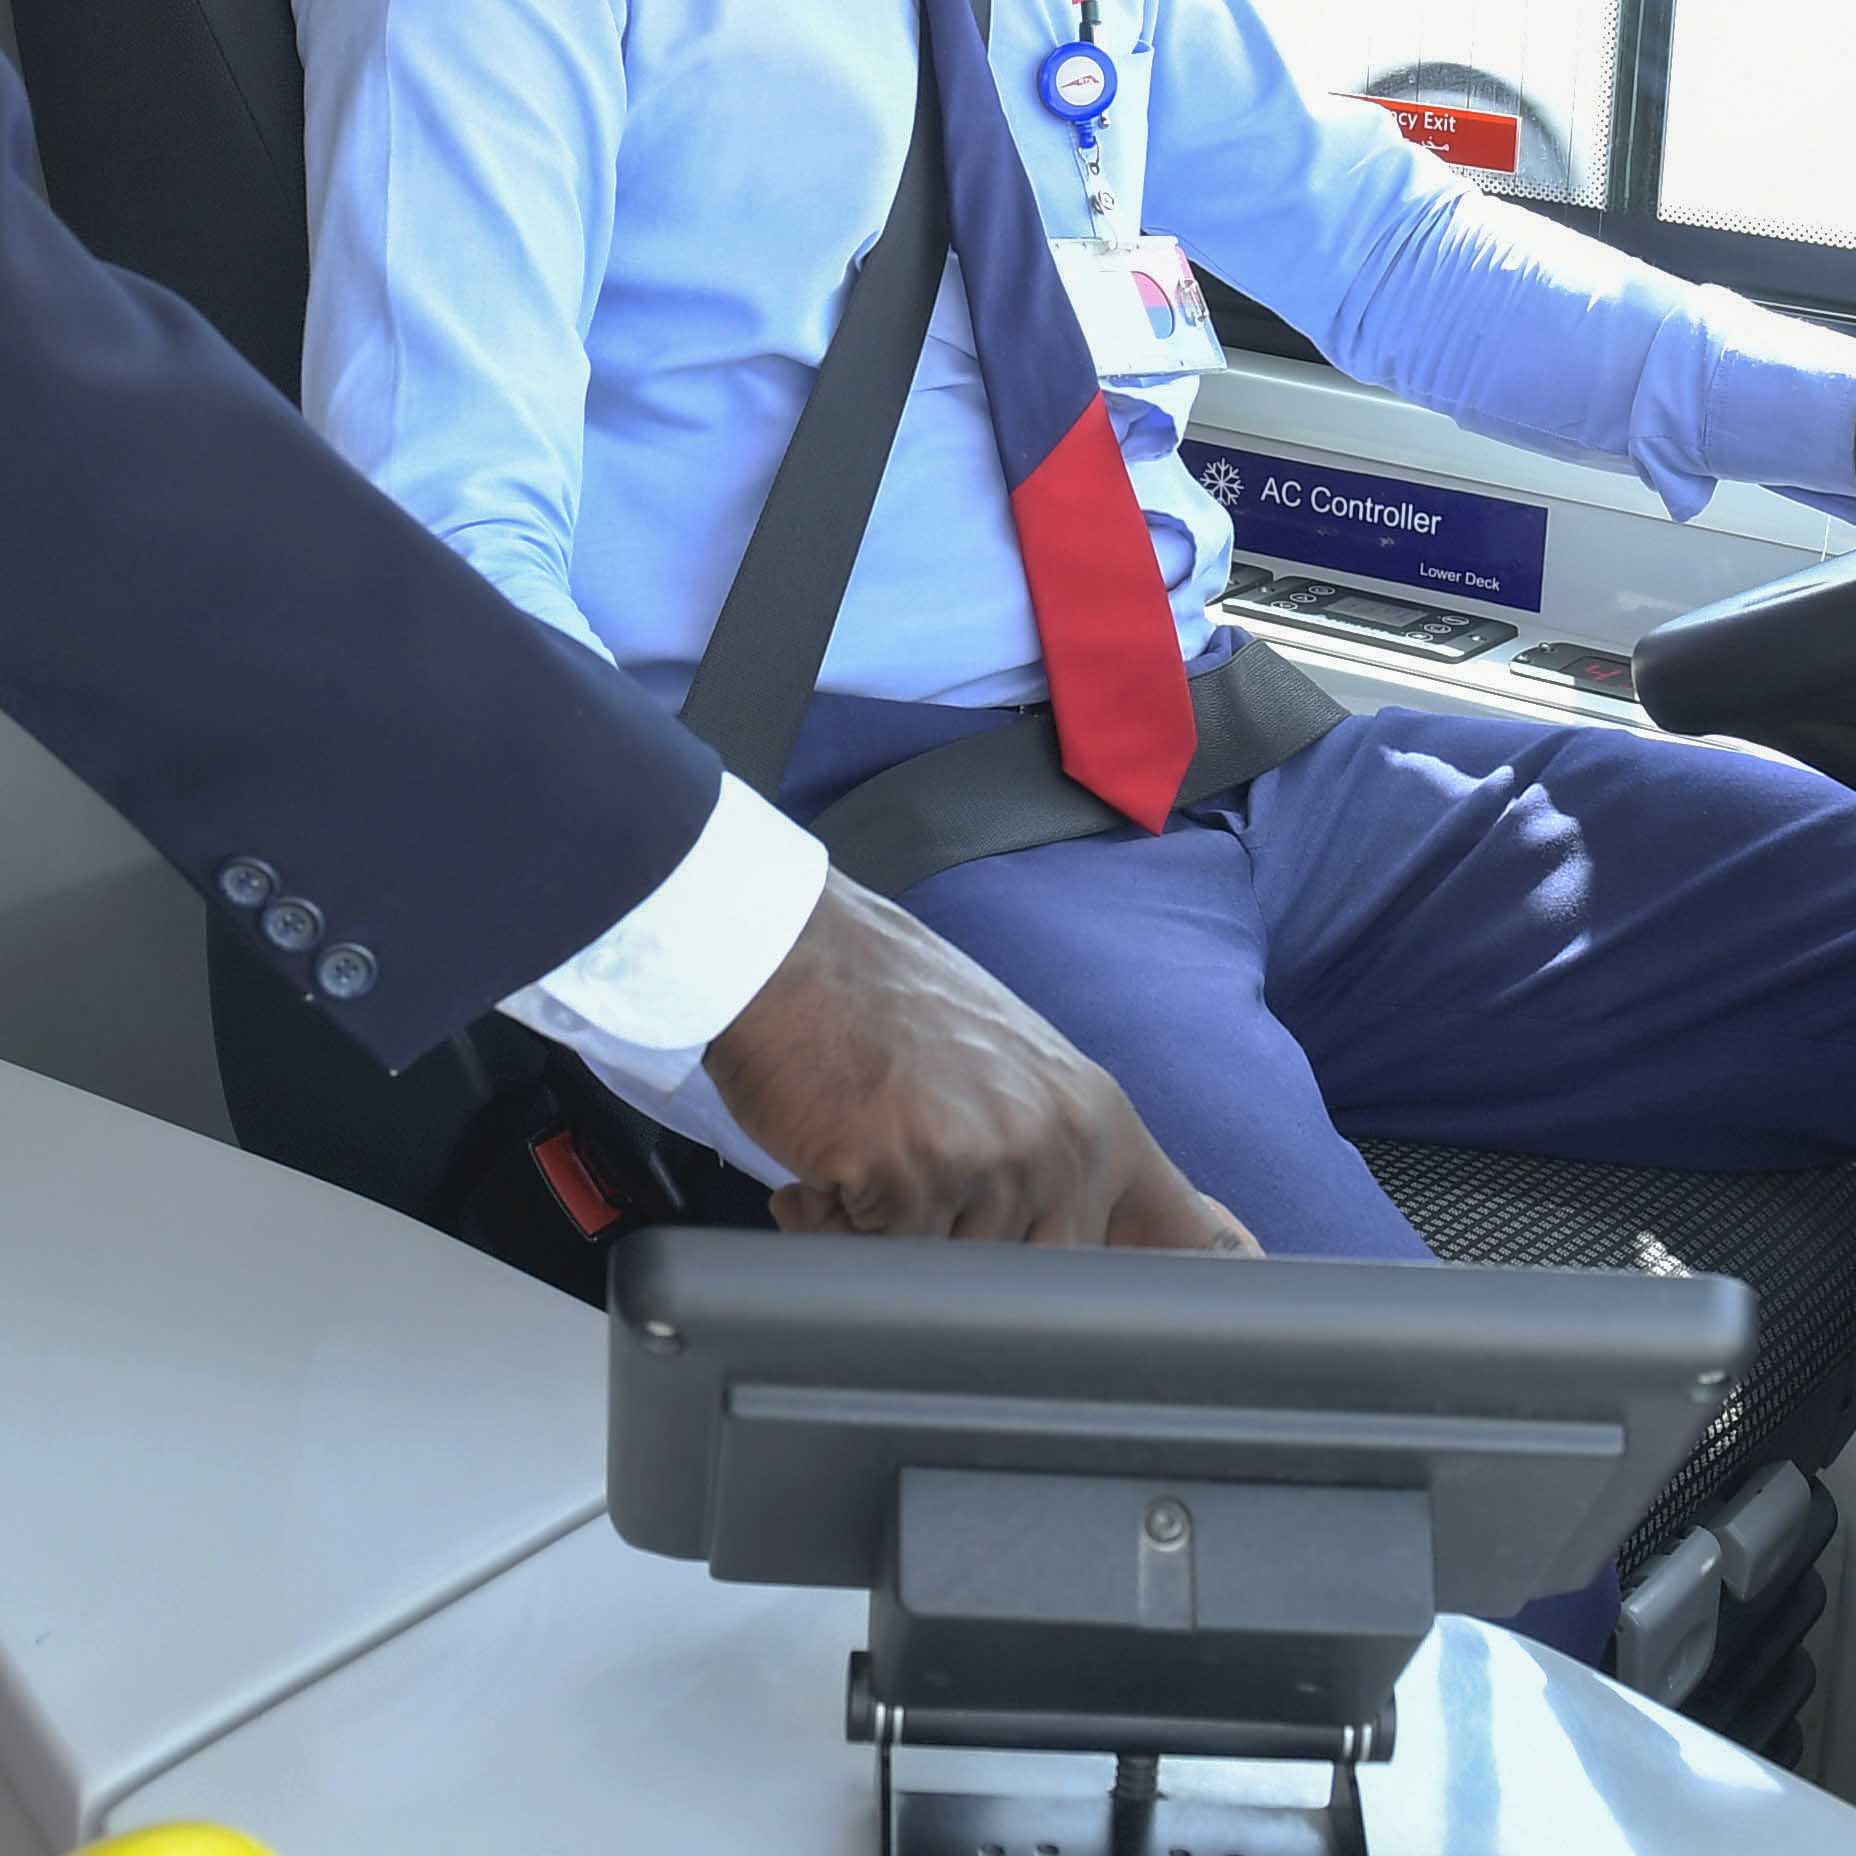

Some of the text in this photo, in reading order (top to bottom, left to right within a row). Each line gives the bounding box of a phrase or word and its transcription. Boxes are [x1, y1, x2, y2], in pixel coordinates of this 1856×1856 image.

[1424, 111, 1456, 133] Exit
[1260, 476, 1443, 536] AC Controller
[1419, 561, 1501, 592] Lower Deck
